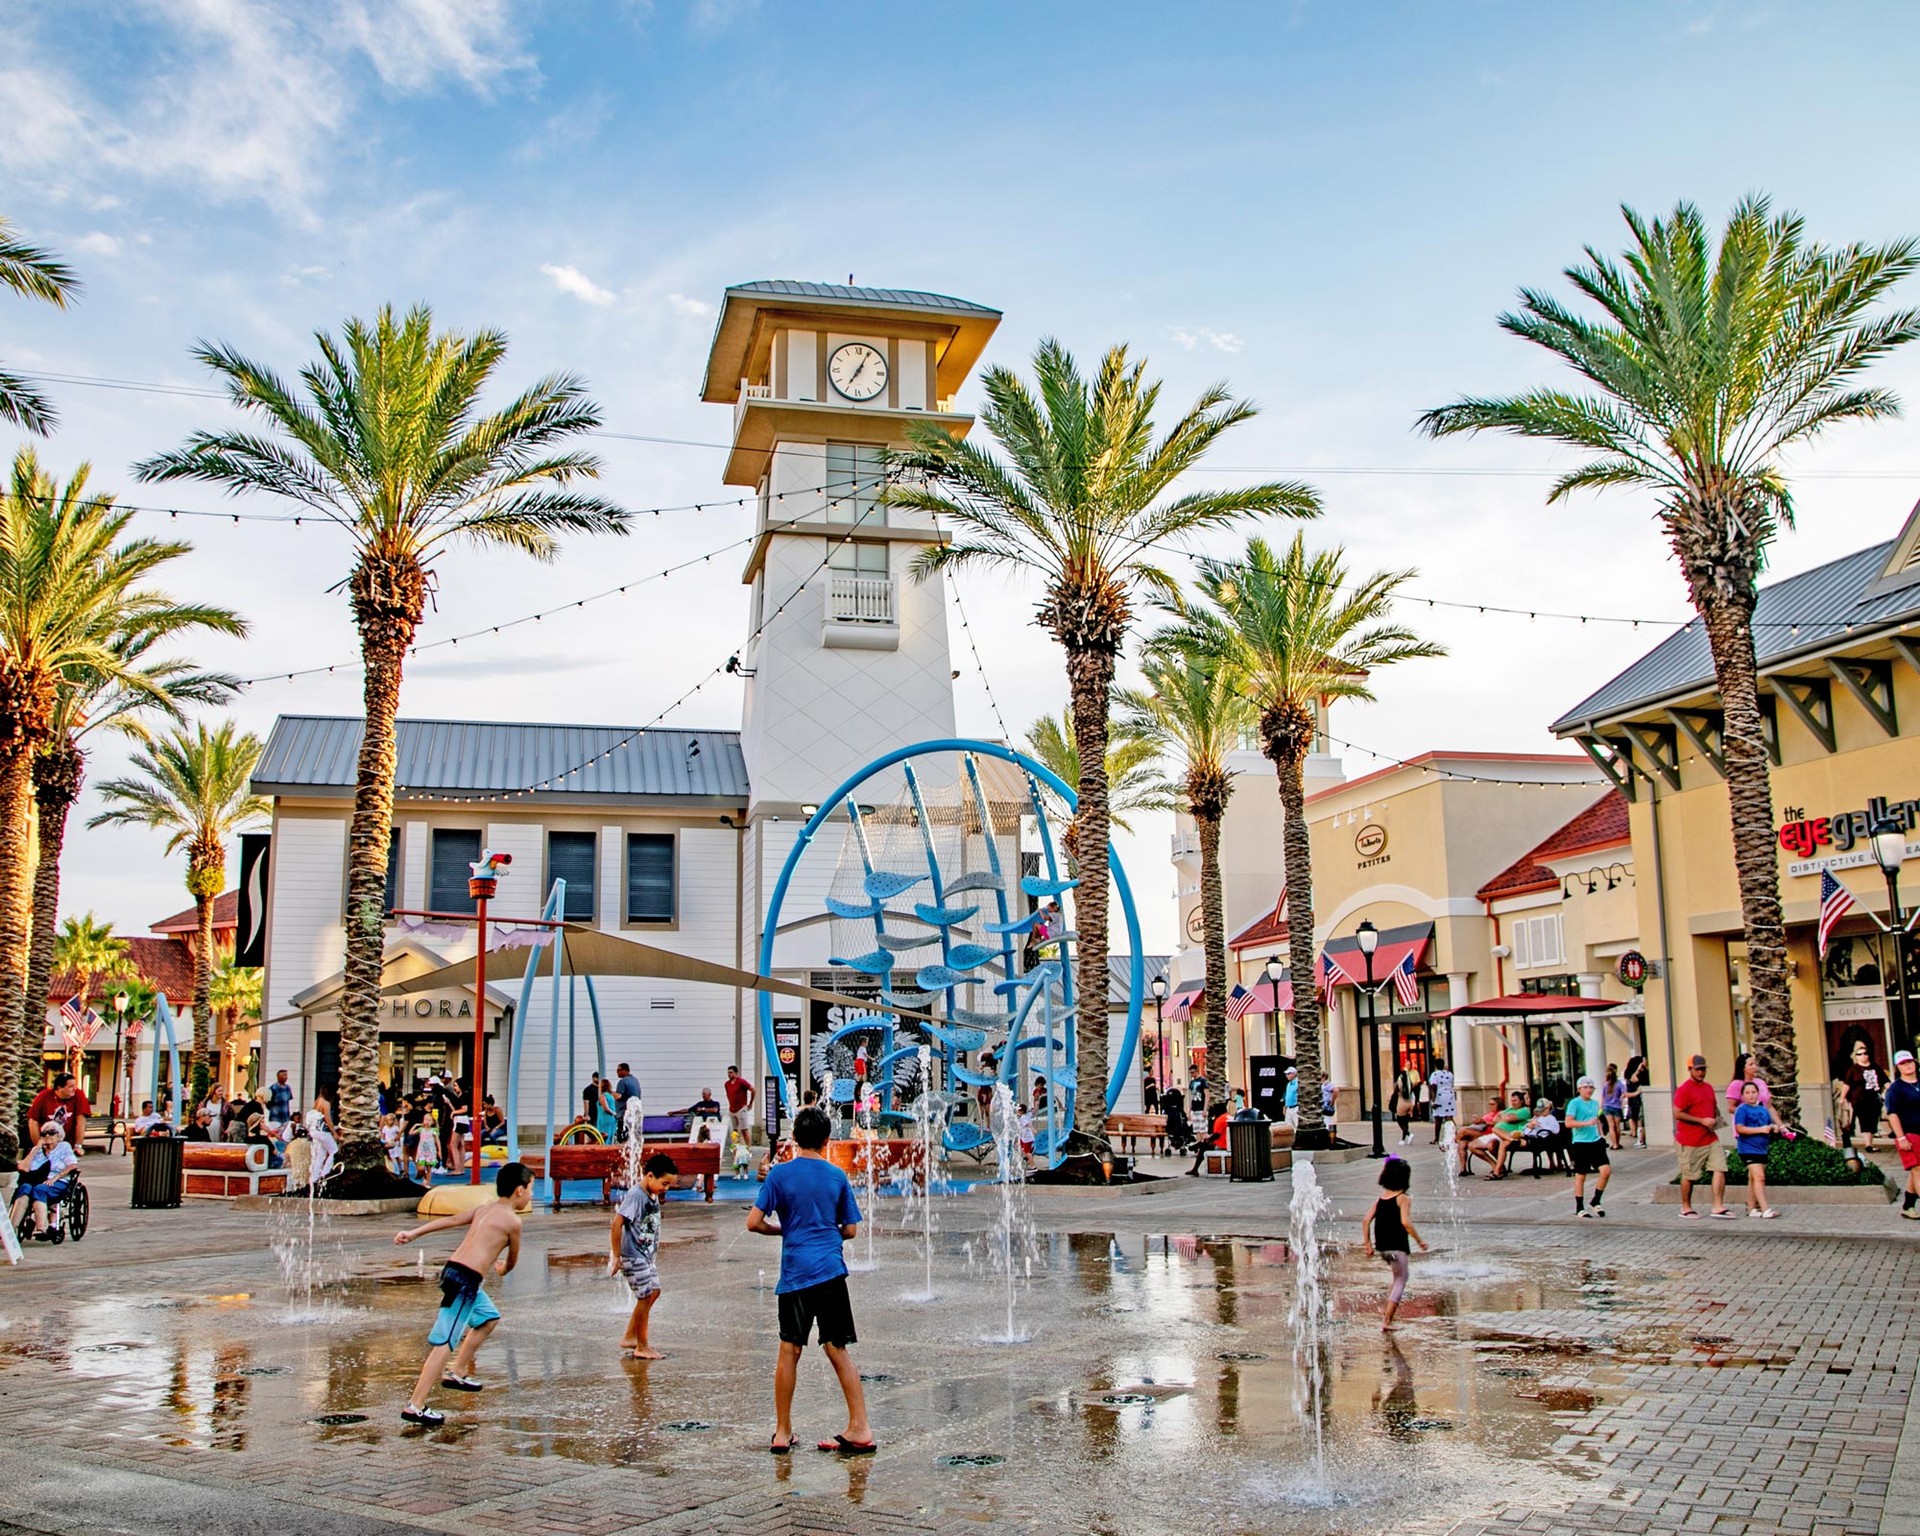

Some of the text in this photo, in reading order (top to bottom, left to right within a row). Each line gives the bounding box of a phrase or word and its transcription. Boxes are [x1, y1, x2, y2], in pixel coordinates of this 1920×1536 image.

[1784, 806, 1804, 822] the
[1832, 797, 1920, 850] galler
[1357, 855, 1391, 870] PETITES
[1791, 855, 1865, 873] DISTINCTIVE
[1839, 1006, 1872, 1016] GUCCI
